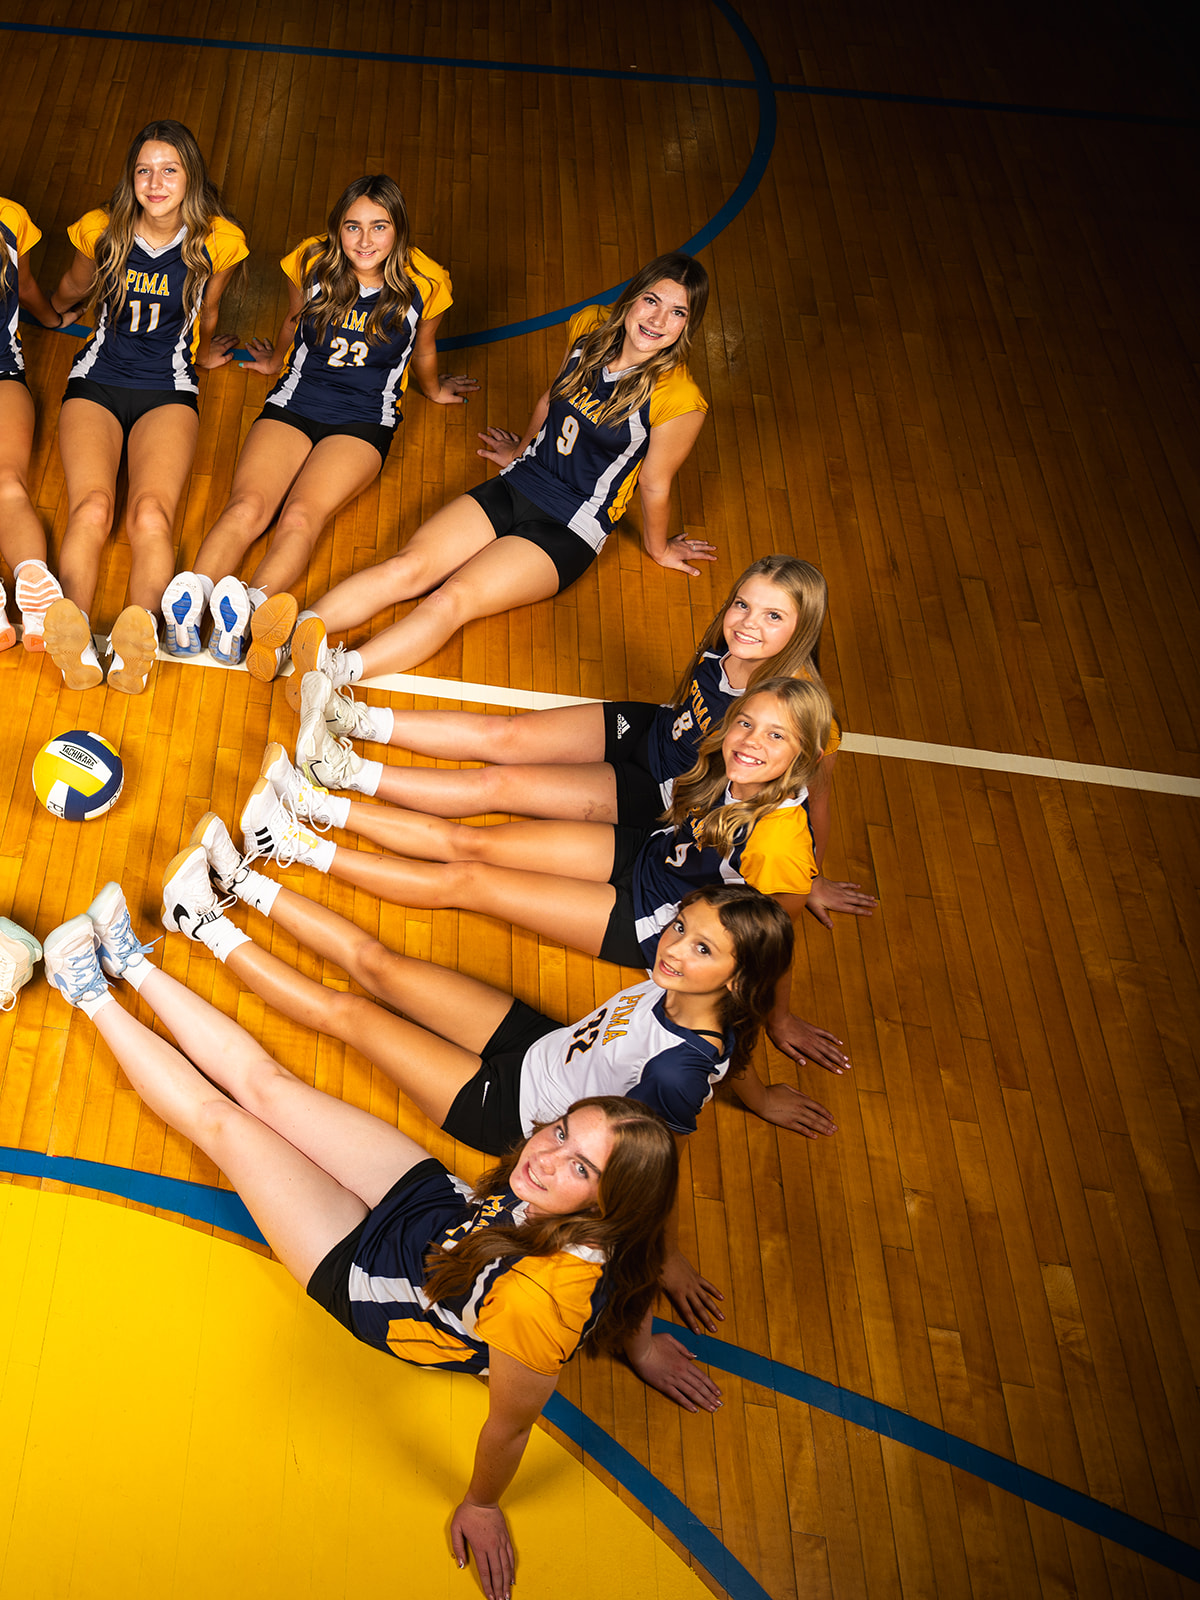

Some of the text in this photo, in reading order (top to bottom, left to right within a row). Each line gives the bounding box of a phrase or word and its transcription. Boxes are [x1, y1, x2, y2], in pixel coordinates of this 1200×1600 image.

[125, 268, 170, 297] PIMA
[129, 300, 161, 333] 11
[327, 336, 369, 368] 23
[561, 386, 607, 425] IMA
[556, 415, 580, 456] 9
[671, 709, 694, 741] 8
[62, 744, 97, 768] TACHIKARA
[601, 992, 646, 1047] PIMA
